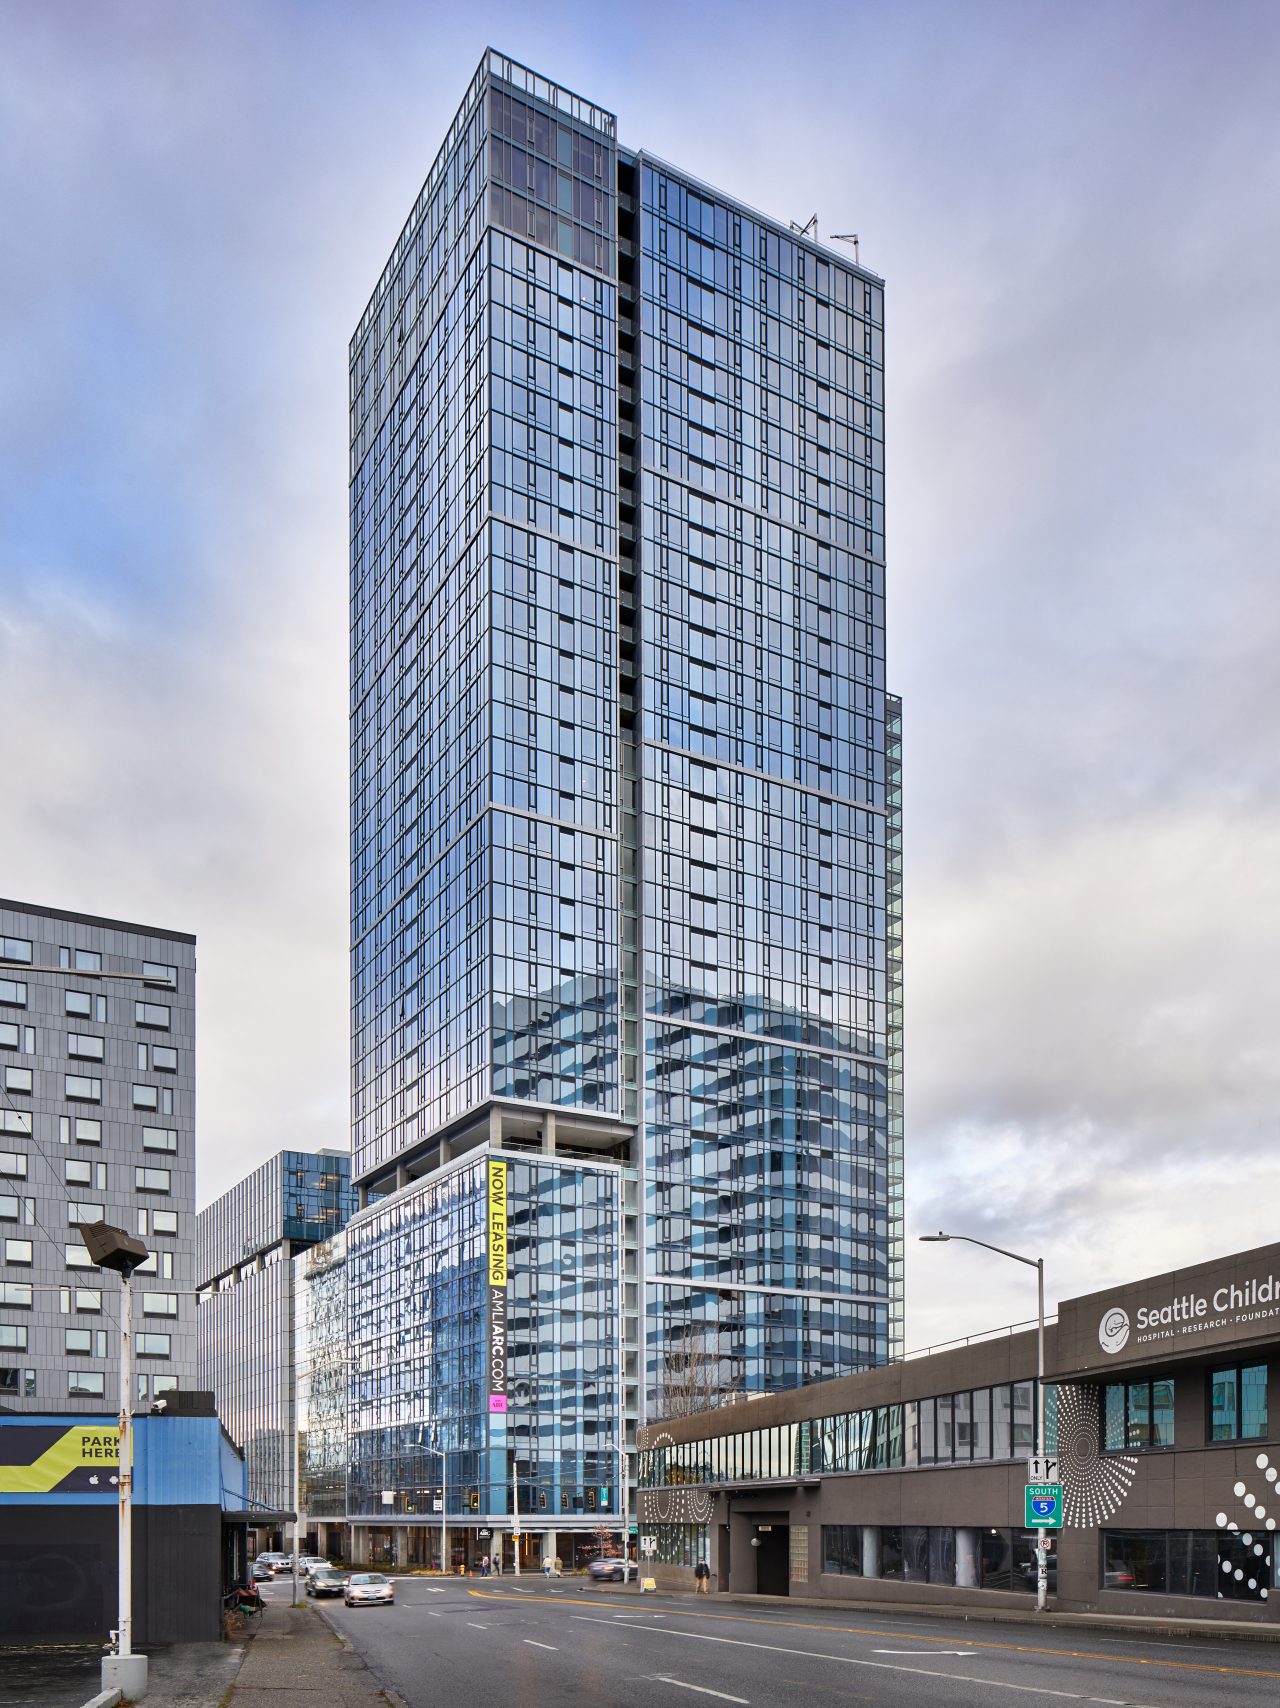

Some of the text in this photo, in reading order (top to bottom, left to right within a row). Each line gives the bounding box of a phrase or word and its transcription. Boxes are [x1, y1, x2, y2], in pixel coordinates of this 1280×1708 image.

[491, 1166, 504, 1281] NOW LEASING
[1136, 1293, 1208, 1330] Seattle
[491, 1288, 504, 1392] AMLIARC.COM
[1137, 1329, 1175, 1343] HOSPITAL
[1182, 1318, 1227, 1334] RESEARCH
[1029, 1487, 1058, 1495] SOUTH
[1040, 1502, 1048, 1513] 5
